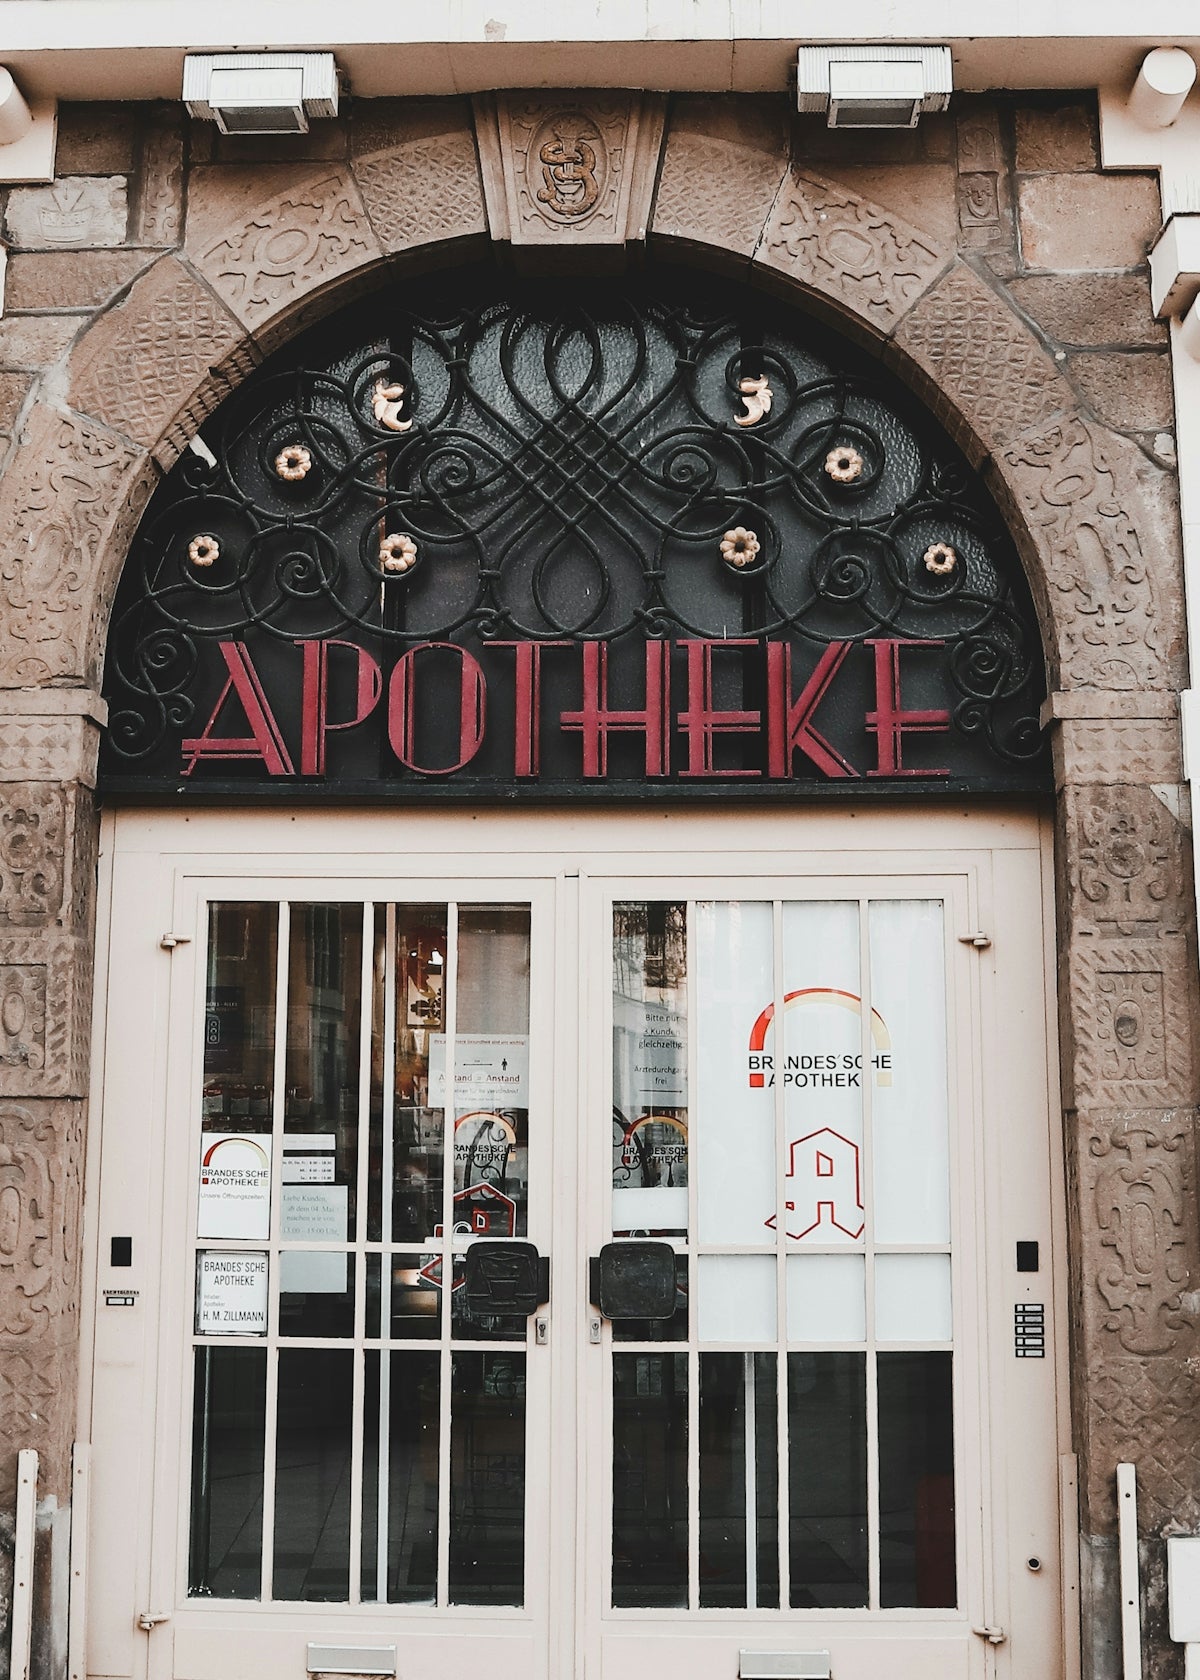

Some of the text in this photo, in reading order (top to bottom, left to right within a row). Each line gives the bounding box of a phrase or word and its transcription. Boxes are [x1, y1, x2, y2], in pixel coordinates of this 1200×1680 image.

[180, 639, 950, 779] APOTHEKE
[645, 1013, 664, 1022] Bitte
[748, 1055, 892, 1069] BRNDES'SCHE
[438, 1073, 473, 1082] Atand
[487, 1074, 520, 1082] Anstand
[768, 1073, 861, 1087] APOTHEK
[210, 1178, 259, 1187] APOTHEKE
[213, 1275, 255, 1286] APOTHEKE
[223, 1310, 264, 1321] ZILLMANN
